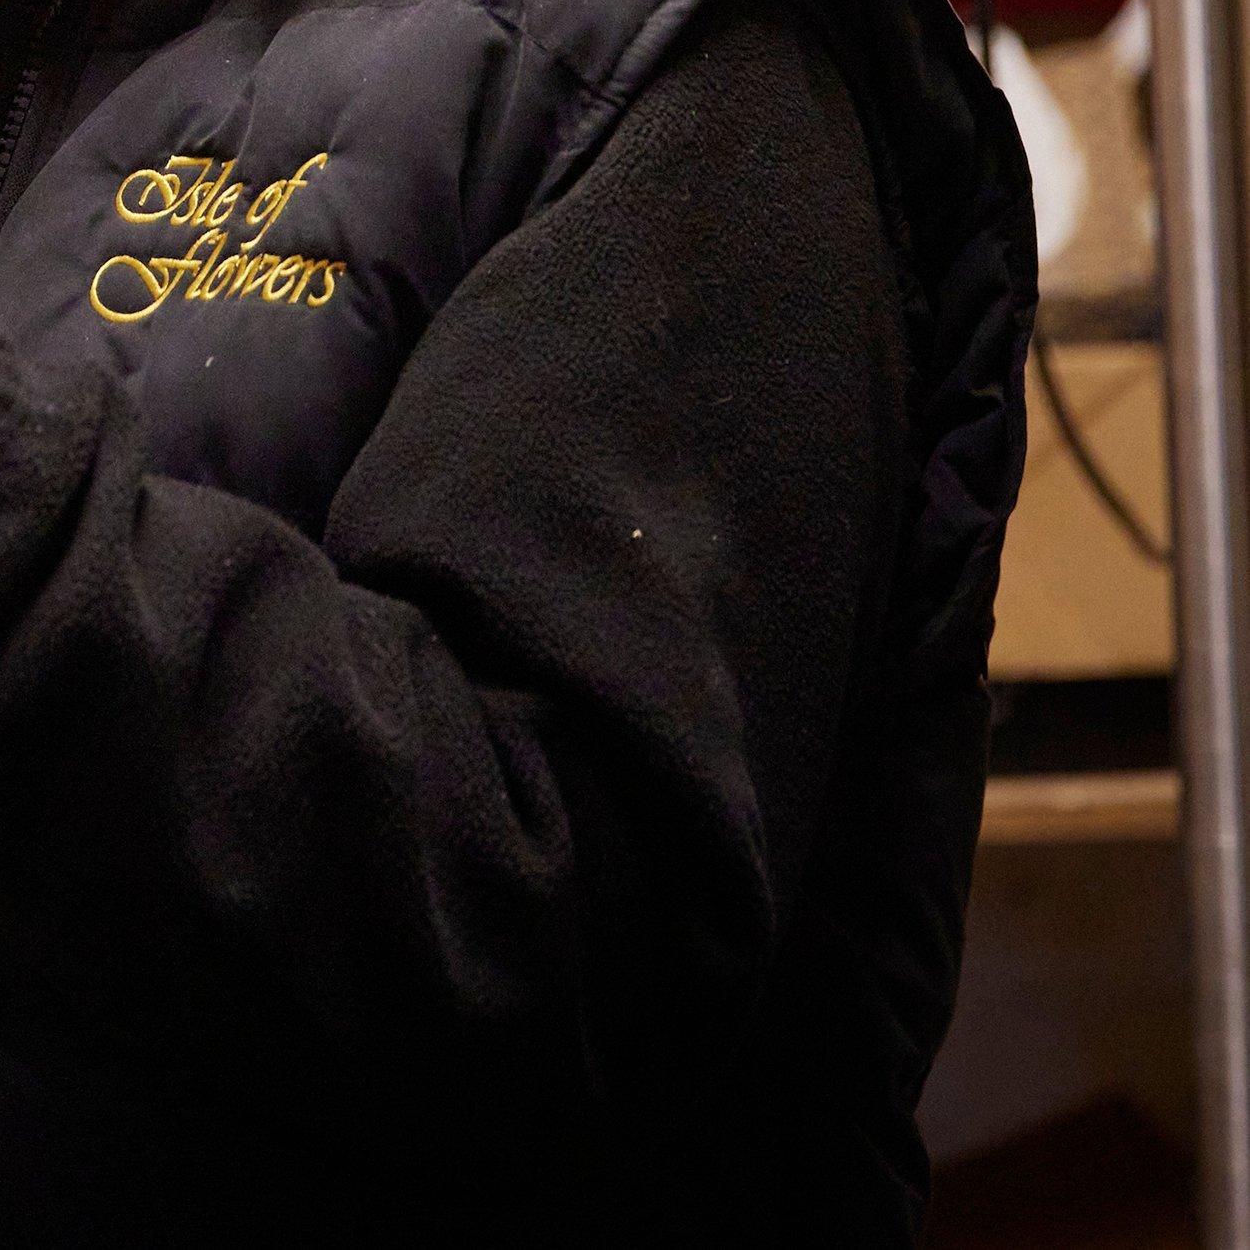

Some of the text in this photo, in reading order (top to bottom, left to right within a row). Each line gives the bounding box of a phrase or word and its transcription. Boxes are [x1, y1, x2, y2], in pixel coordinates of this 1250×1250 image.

[116, 152, 328, 251] Isle of
[90, 228, 347, 323] Flowers
